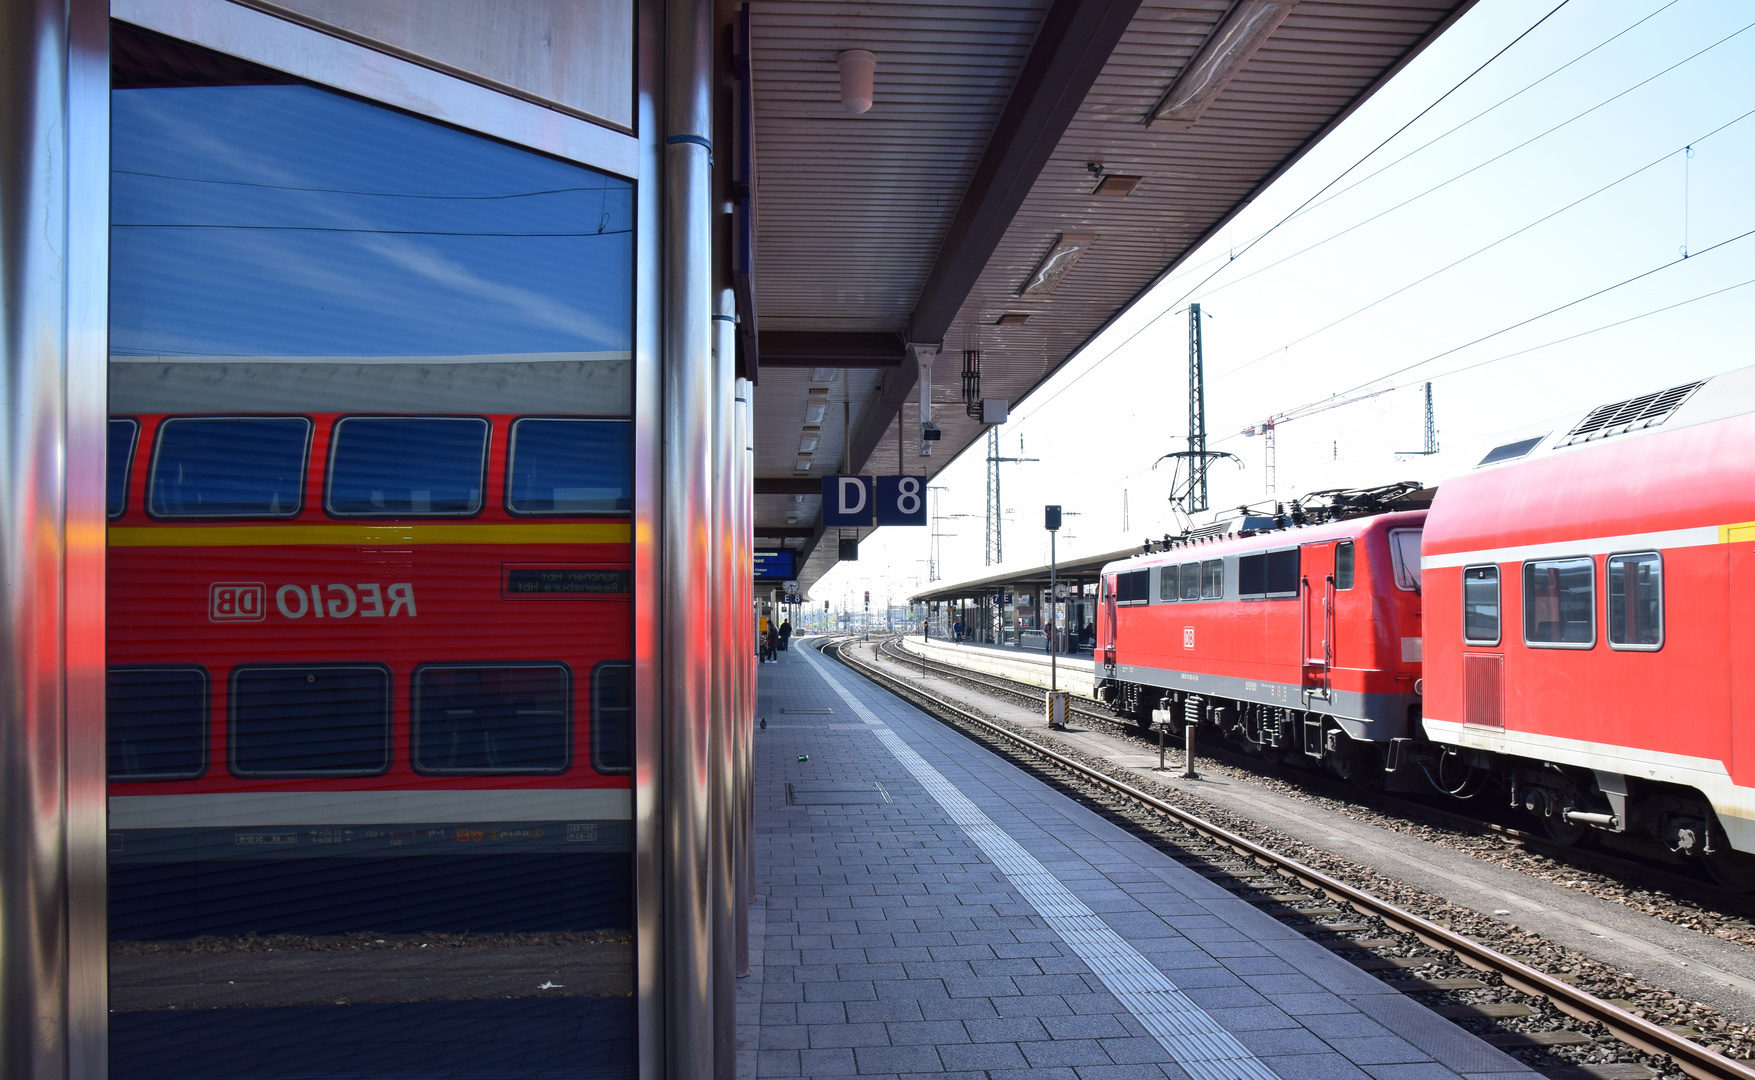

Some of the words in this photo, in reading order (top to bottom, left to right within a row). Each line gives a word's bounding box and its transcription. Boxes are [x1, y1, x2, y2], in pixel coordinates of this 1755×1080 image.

[838, 477, 867, 514] D
[897, 477, 921, 514] 8
[784, 594, 790, 602] E
[794, 594, 800, 602] 8
[1004, 594, 1009, 602] E
